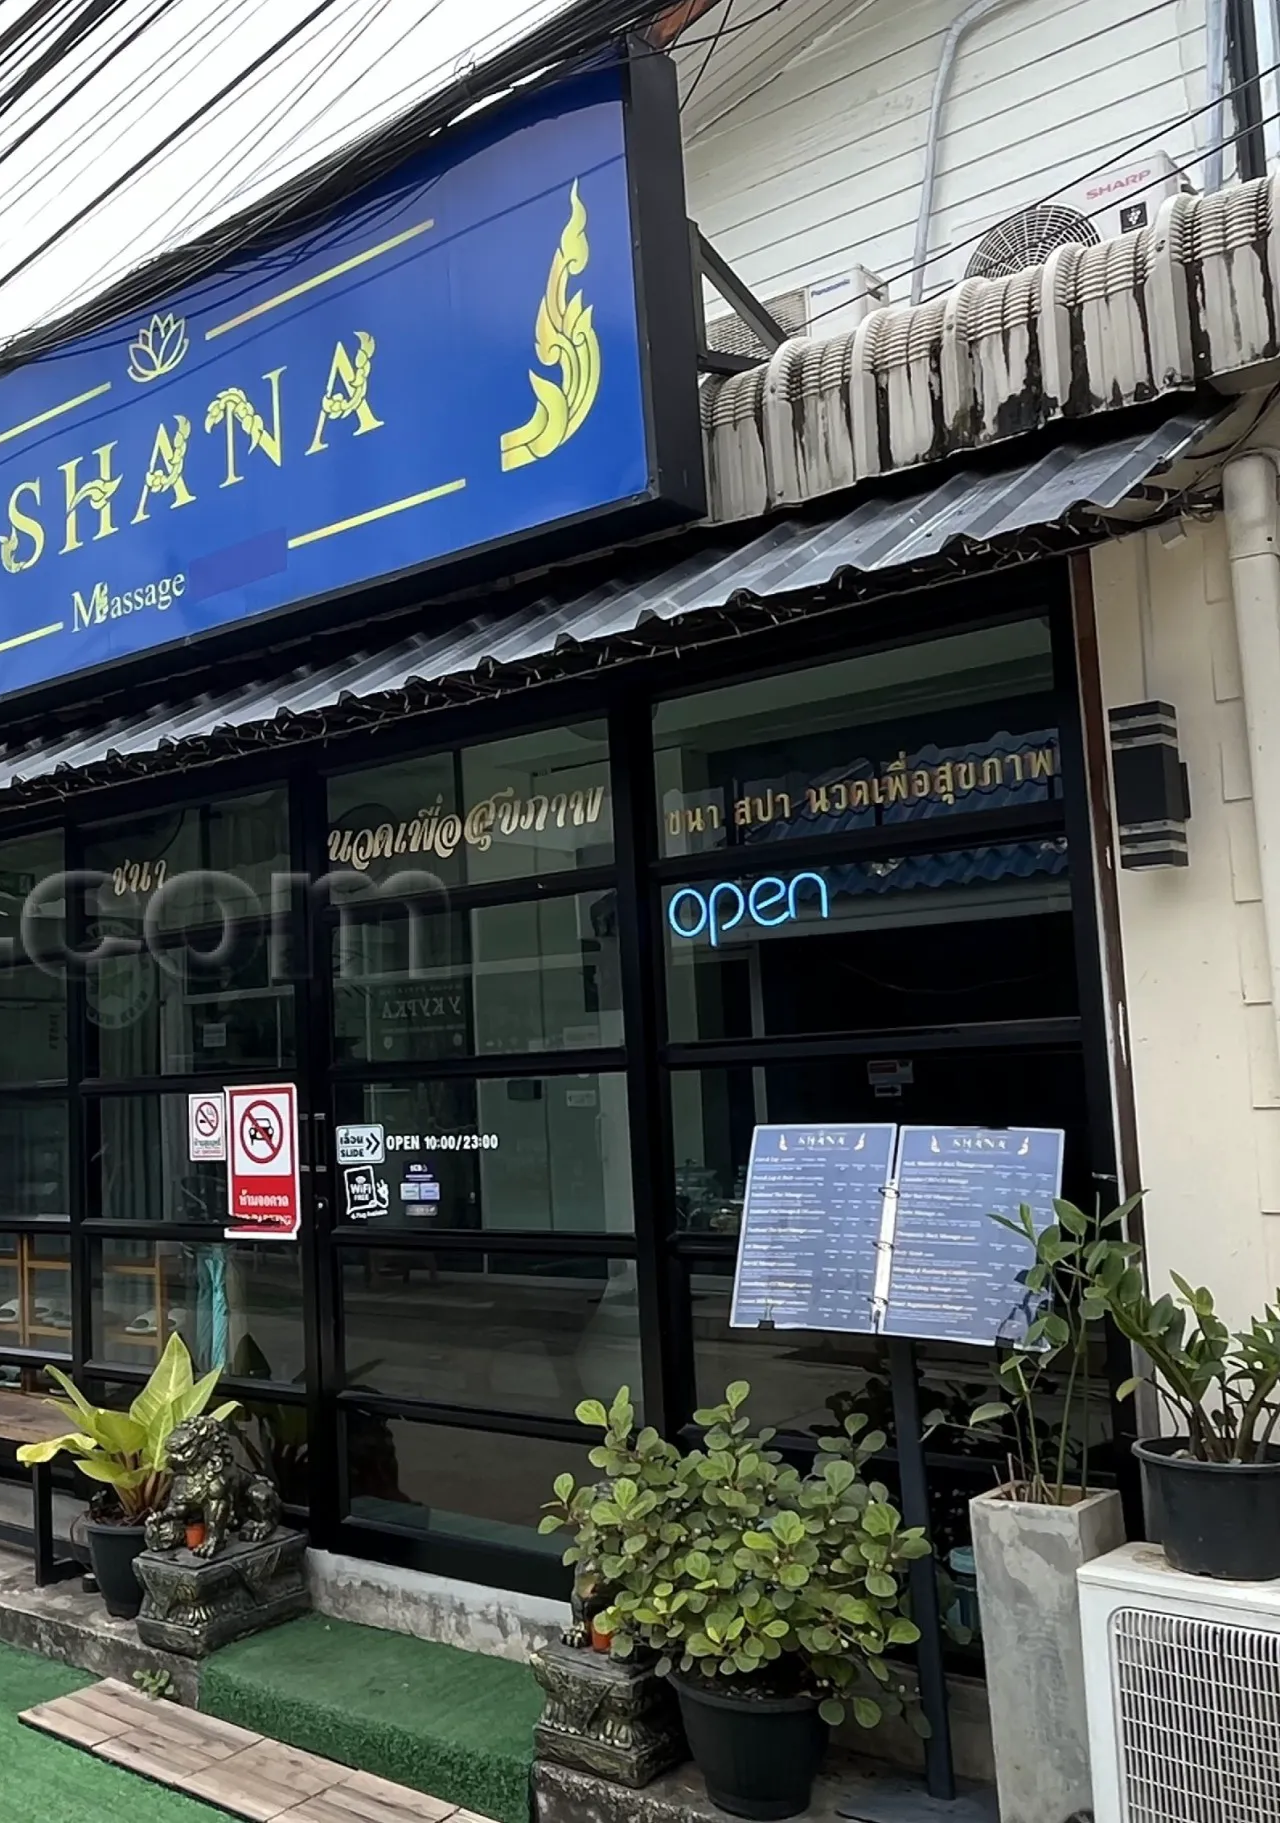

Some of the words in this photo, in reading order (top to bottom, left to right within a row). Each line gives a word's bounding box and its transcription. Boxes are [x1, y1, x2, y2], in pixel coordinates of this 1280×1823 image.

[1086, 169, 1151, 200] SHARP
[71, 573, 186, 633] Massage
[734, 788, 791, 825] สปา
[808, 750, 1054, 806] นวดเพื่อสุขภาพ
[668, 871, 829, 948] open
[340, 1149, 364, 1158] SLIDE
[386, 1135, 420, 1150] OPEN
[424, 1134, 499, 1151] 10:00/23:00
